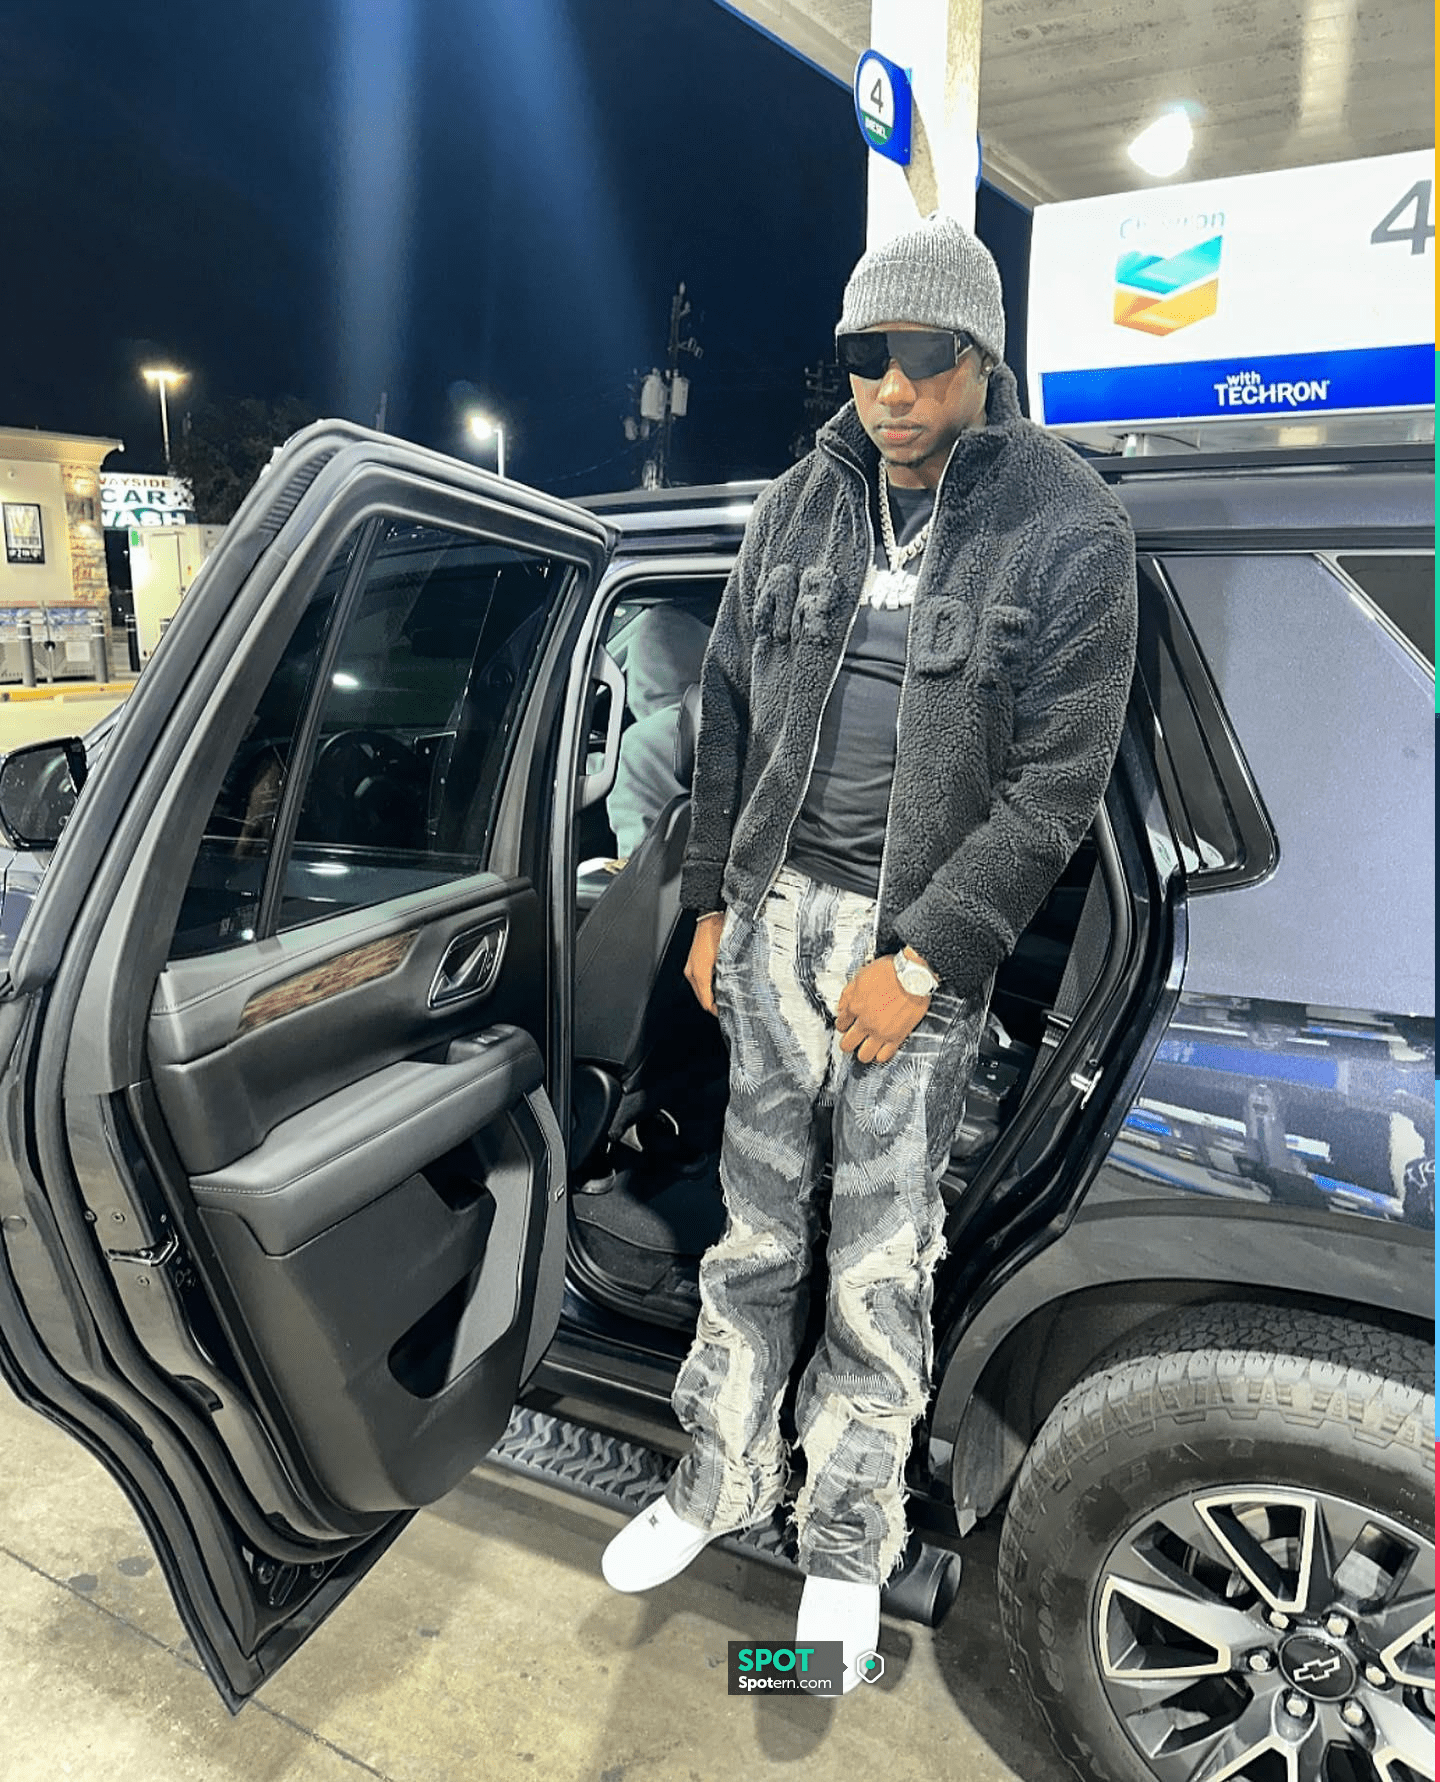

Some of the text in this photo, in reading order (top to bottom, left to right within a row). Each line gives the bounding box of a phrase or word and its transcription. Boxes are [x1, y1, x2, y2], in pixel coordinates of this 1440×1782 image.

[870, 77, 884, 114] 4
[1369, 179, 1436, 256] 4
[1226, 370, 1261, 386] with
[1213, 380, 1328, 407] TECHRON
[100, 488, 167, 505] CAR
